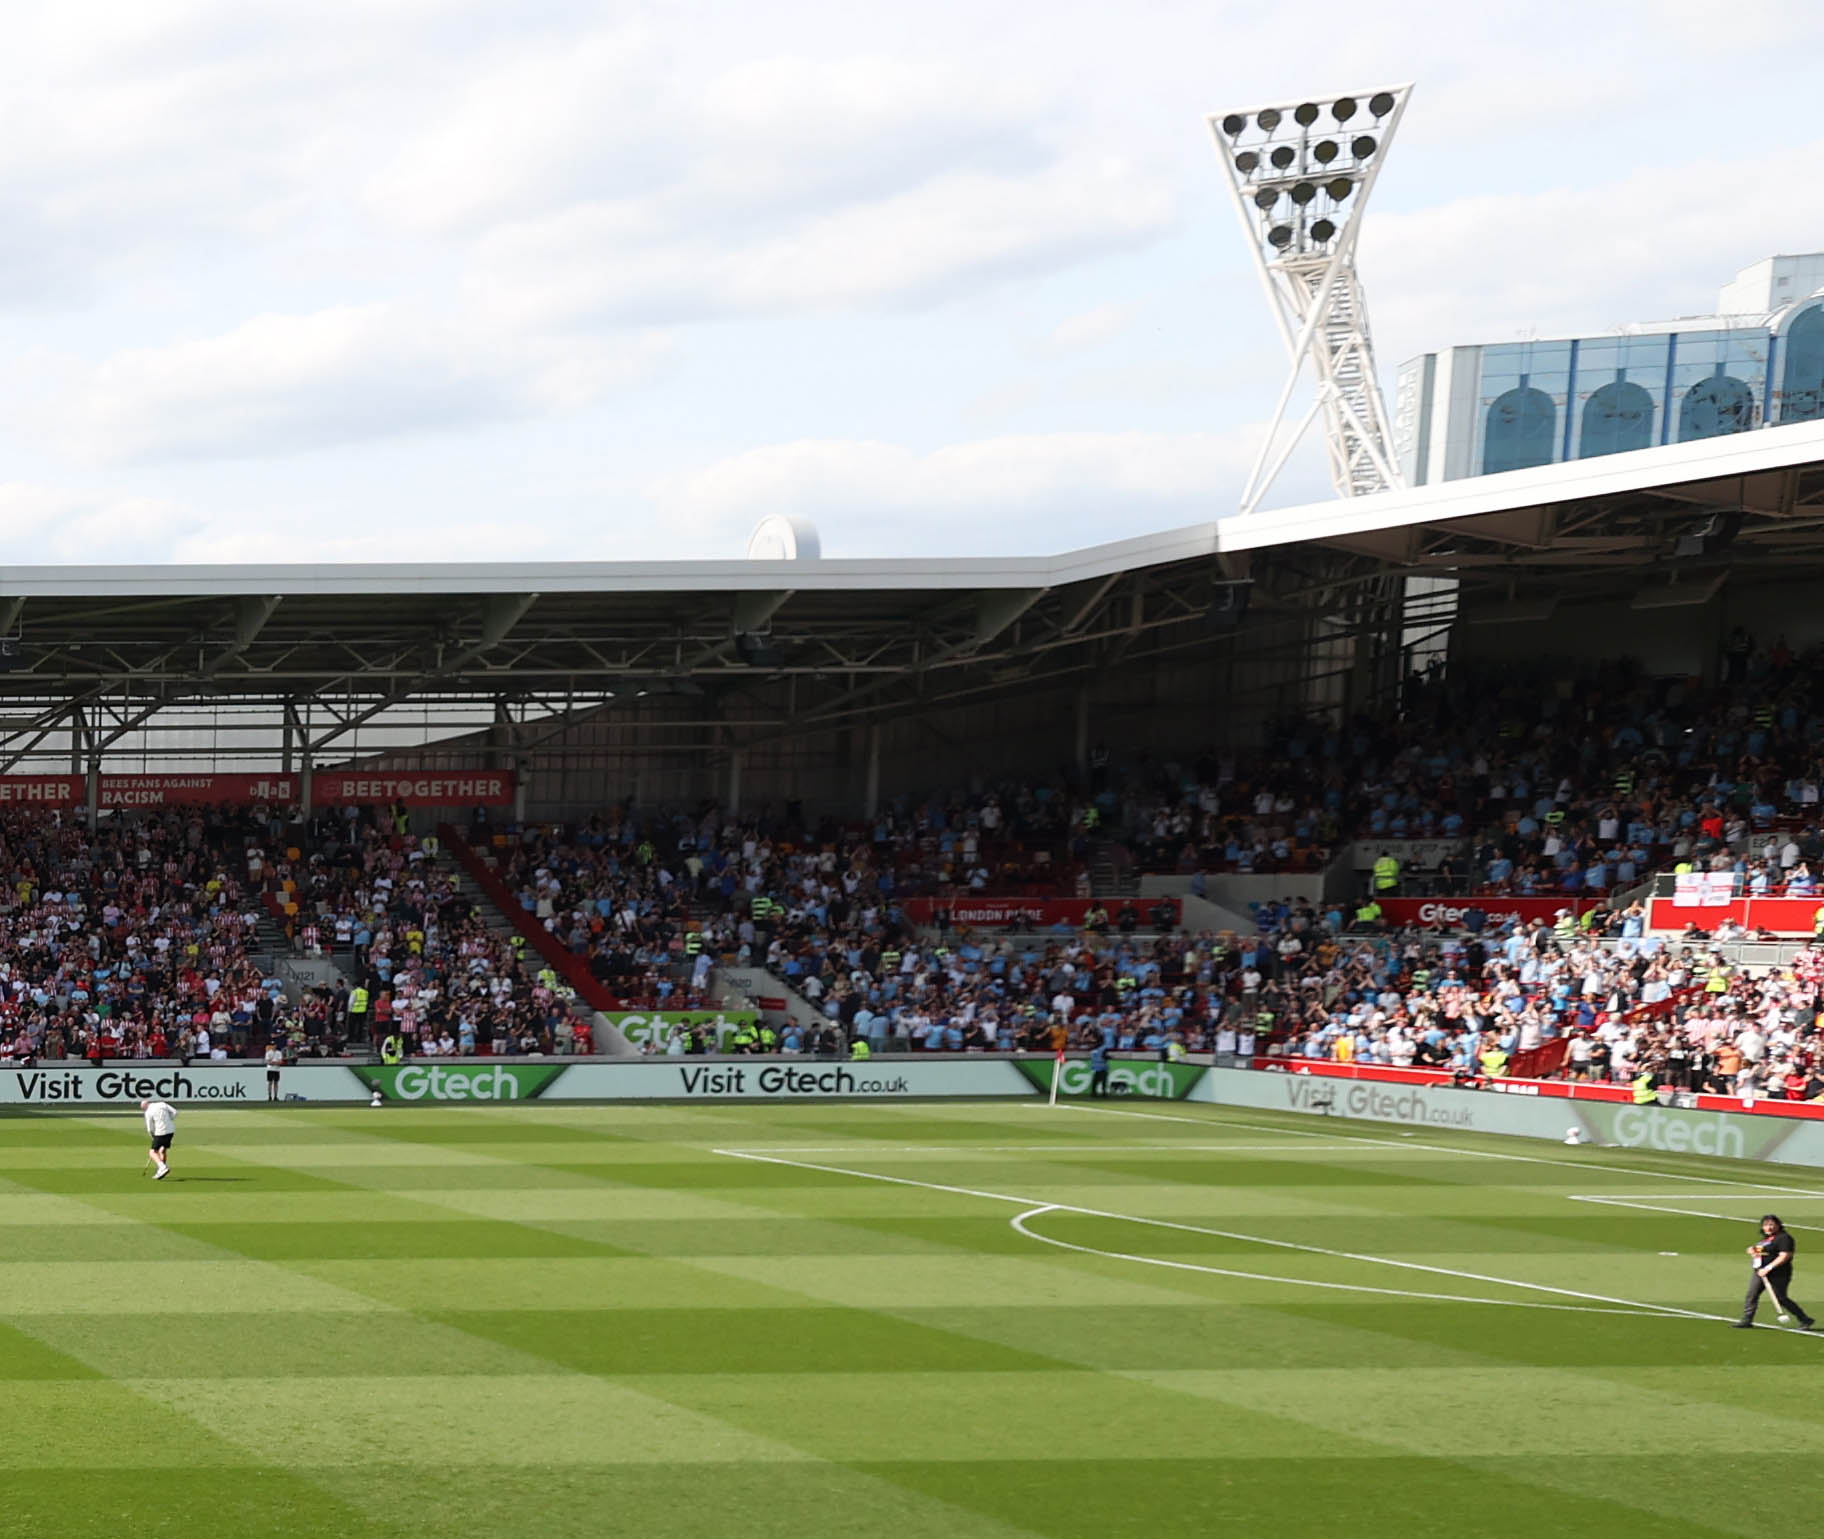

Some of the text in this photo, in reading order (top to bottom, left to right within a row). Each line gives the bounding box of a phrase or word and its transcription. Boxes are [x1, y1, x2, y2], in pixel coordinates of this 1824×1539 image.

[102, 778, 213, 788] BEES FANS AGAINST
[102, 791, 164, 805] RACISM
[16, 1071, 246, 1100] Visit Gtech.co.uk
[394, 1065, 519, 1100] Gtech
[680, 1065, 908, 1094] Visit Gtech.co.uk
[1058, 1060, 1175, 1098] Gech
[1286, 1076, 1338, 1113] Visit
[1613, 1106, 1744, 1159] Gtech
